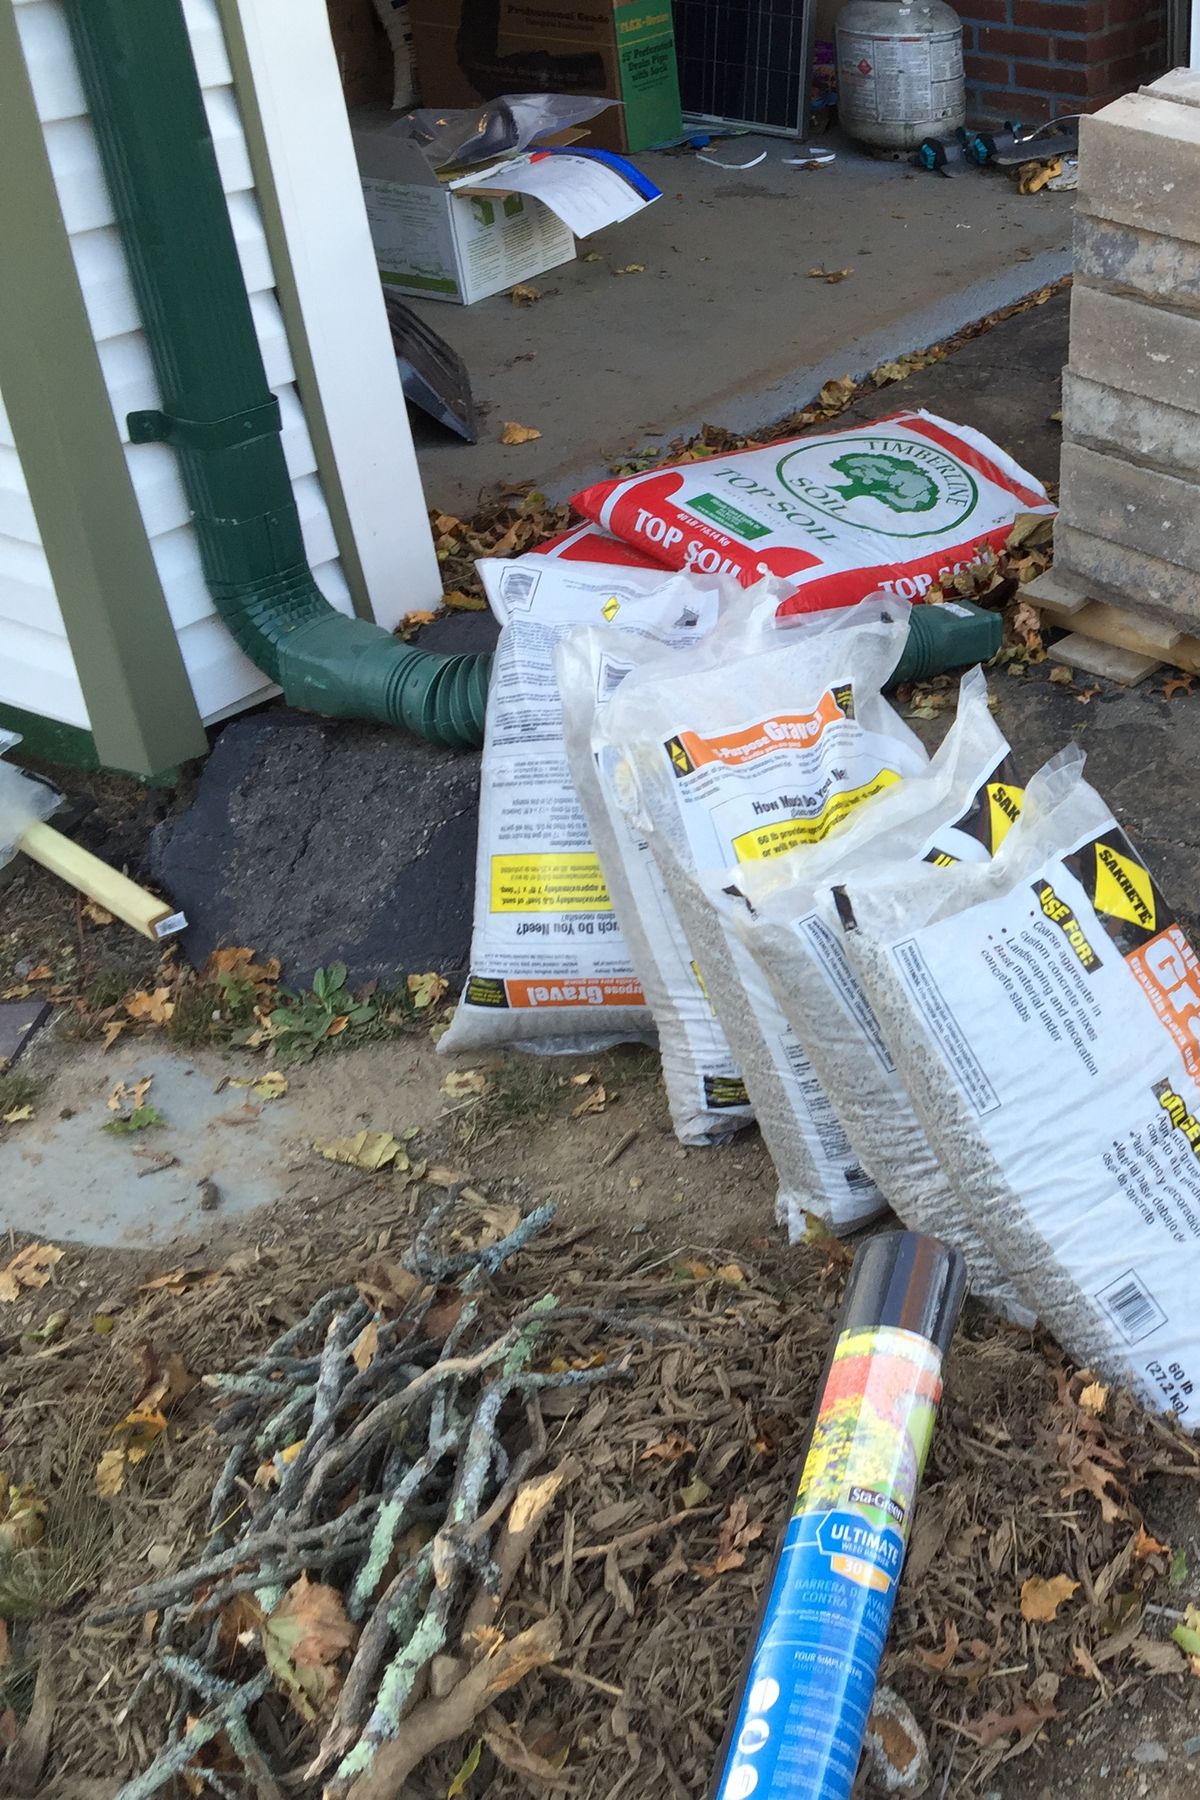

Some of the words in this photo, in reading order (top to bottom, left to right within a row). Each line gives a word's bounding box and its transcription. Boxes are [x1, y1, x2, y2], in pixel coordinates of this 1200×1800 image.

[864, 440, 969, 508] TIMBERLINE
[713, 468, 776, 498] TOP
[766, 494, 840, 546] SOIL
[789, 476, 852, 517] SOIL
[634, 508, 683, 550] TOP
[677, 513, 687, 522] 40
[878, 573, 932, 600] TOP
[763, 712, 823, 741] Gravel
[752, 795, 780, 815] How
[1097, 849, 1154, 926] SAKRETE
[516, 922, 550, 936] Need?
[553, 922, 575, 935] You
[578, 922, 594, 933] Do
[1039, 886, 1070, 922] USE
[1062, 919, 1094, 967] FOR:
[980, 948, 1014, 993] concrete
[1009, 990, 1032, 1023] slabs
[1020, 930, 1051, 961] custom
[1047, 959, 1079, 1007] concrete
[1076, 1006, 1098, 1042] mixes
[1033, 921, 1062, 949] Coarse
[1058, 945, 1095, 1005] aggregate
[1091, 1001, 1102, 1017] in
[526, 985, 604, 1004] Gravel
[993, 944, 1014, 968] Base
[1012, 963, 1043, 1011] material
[1039, 1008, 1063, 1042] under
[1005, 937, 1055, 997] Landscaping
[1049, 994, 1066, 1018] and
[1062, 1015, 1100, 1077] decoration
[1152, 1197, 1180, 1234] debajo
[1145, 1360, 1174, 1395] (27.2
[1169, 1392, 1189, 1415] kg)
[1168, 1362, 1186, 1381] 60
[1181, 1379, 1194, 1396] lb
[851, 1486, 904, 1523] Sta-Green
[830, 1522, 900, 1564] ULTIMATE
[845, 1559, 864, 1575] 30
[795, 1579, 848, 1598] BARRERA
[801, 1590, 848, 1609] CONTRA
[794, 1651, 818, 1662] FOUR
